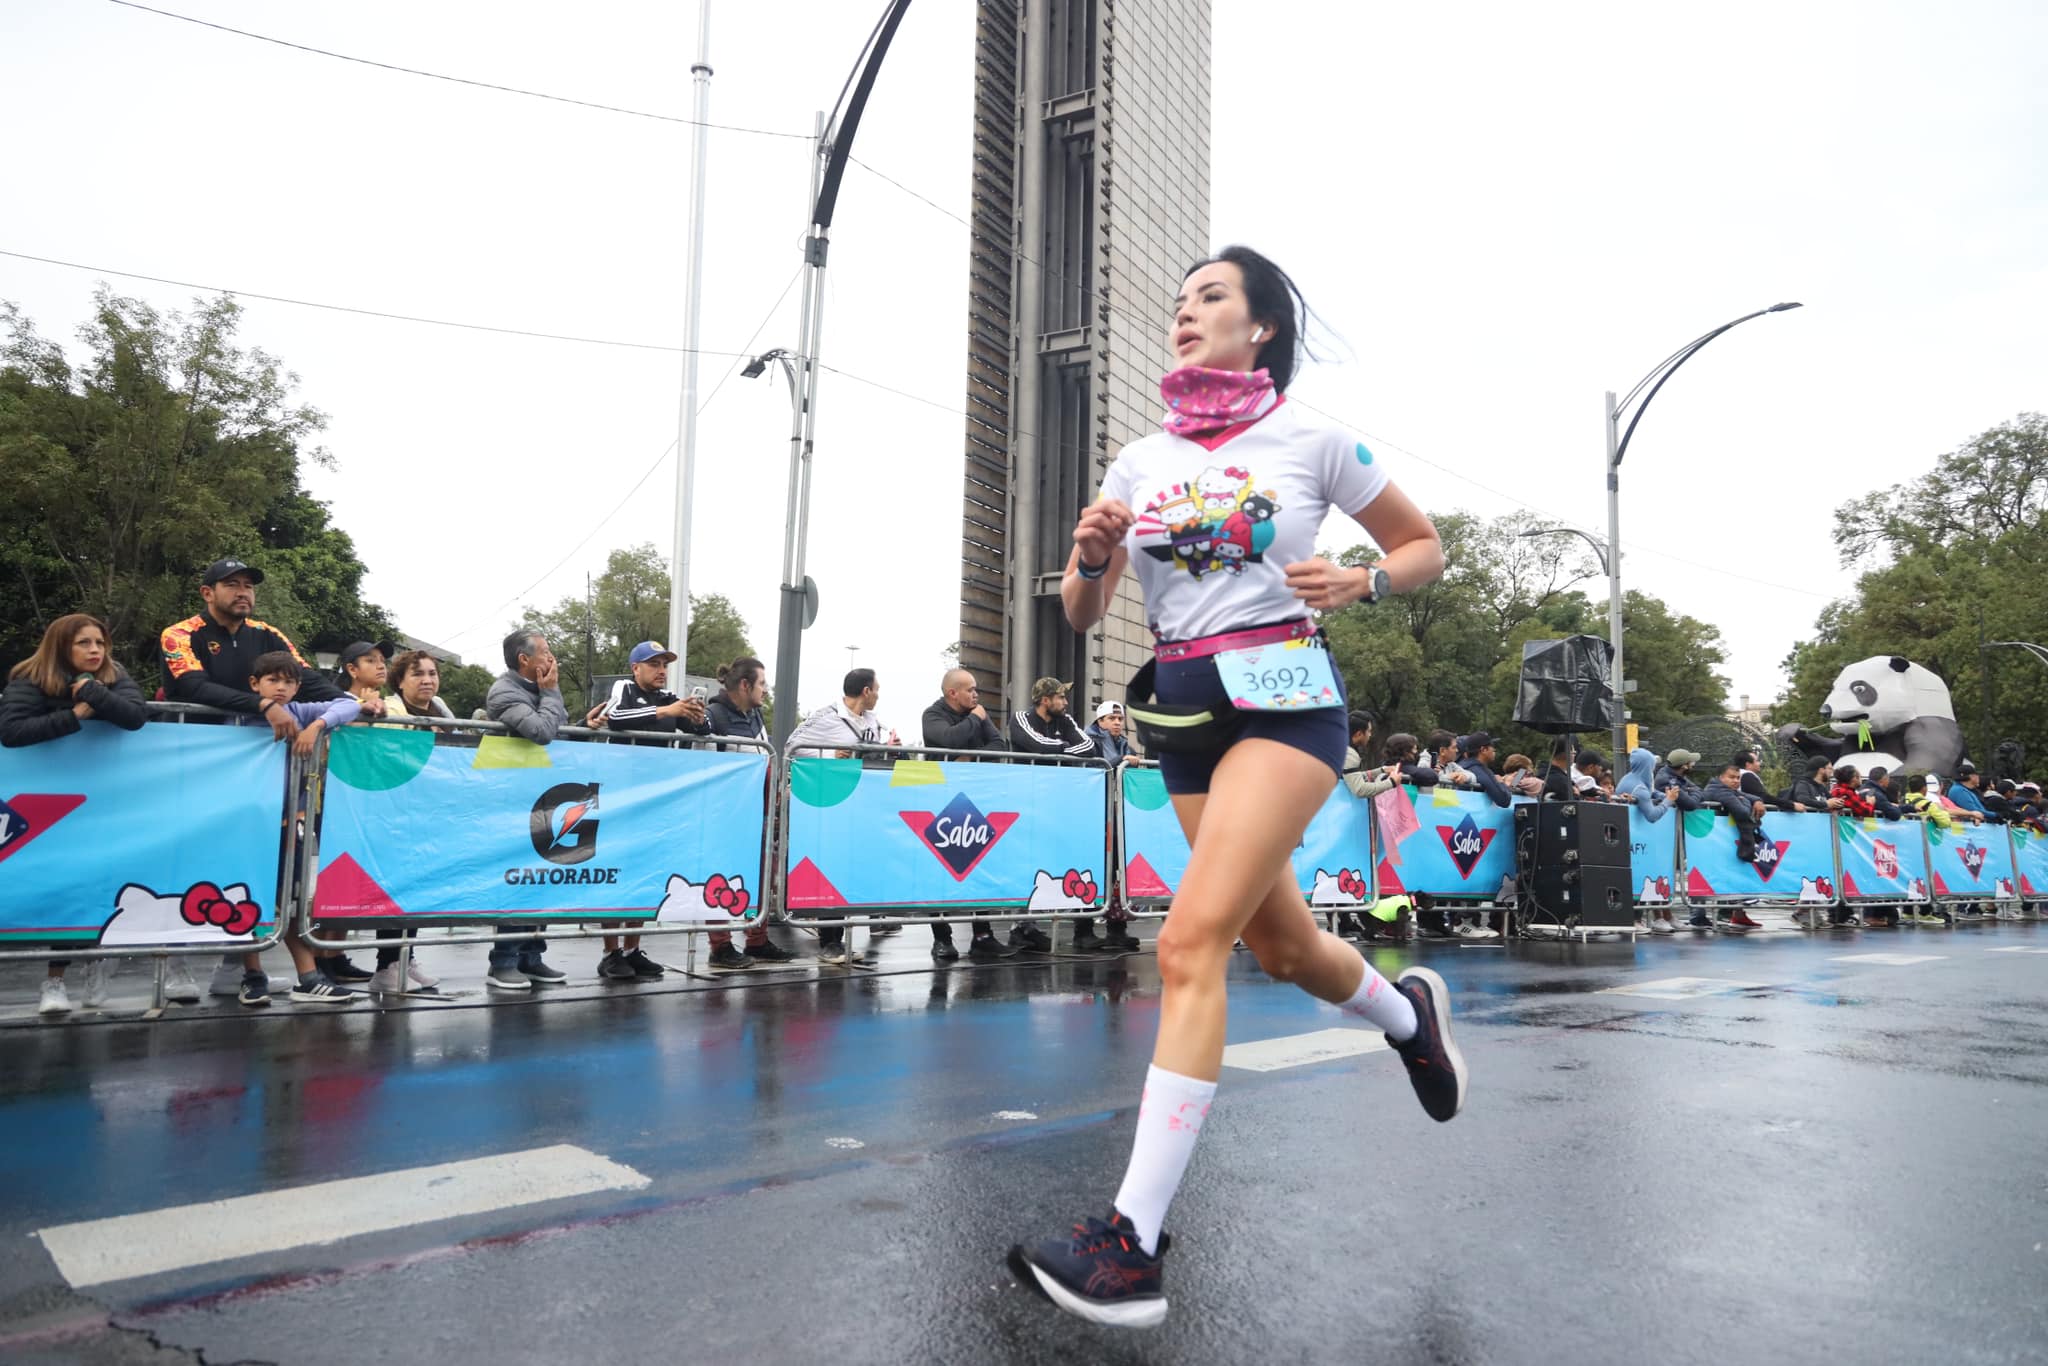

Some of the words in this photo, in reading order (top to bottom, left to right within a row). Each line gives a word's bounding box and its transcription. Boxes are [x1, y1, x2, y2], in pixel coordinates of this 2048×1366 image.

[1243, 666, 1313, 692] 3692
[530, 783, 600, 865] G
[934, 813, 990, 848] Saba
[1453, 829, 1482, 855] Saba
[504, 868, 619, 885] GATORADE
